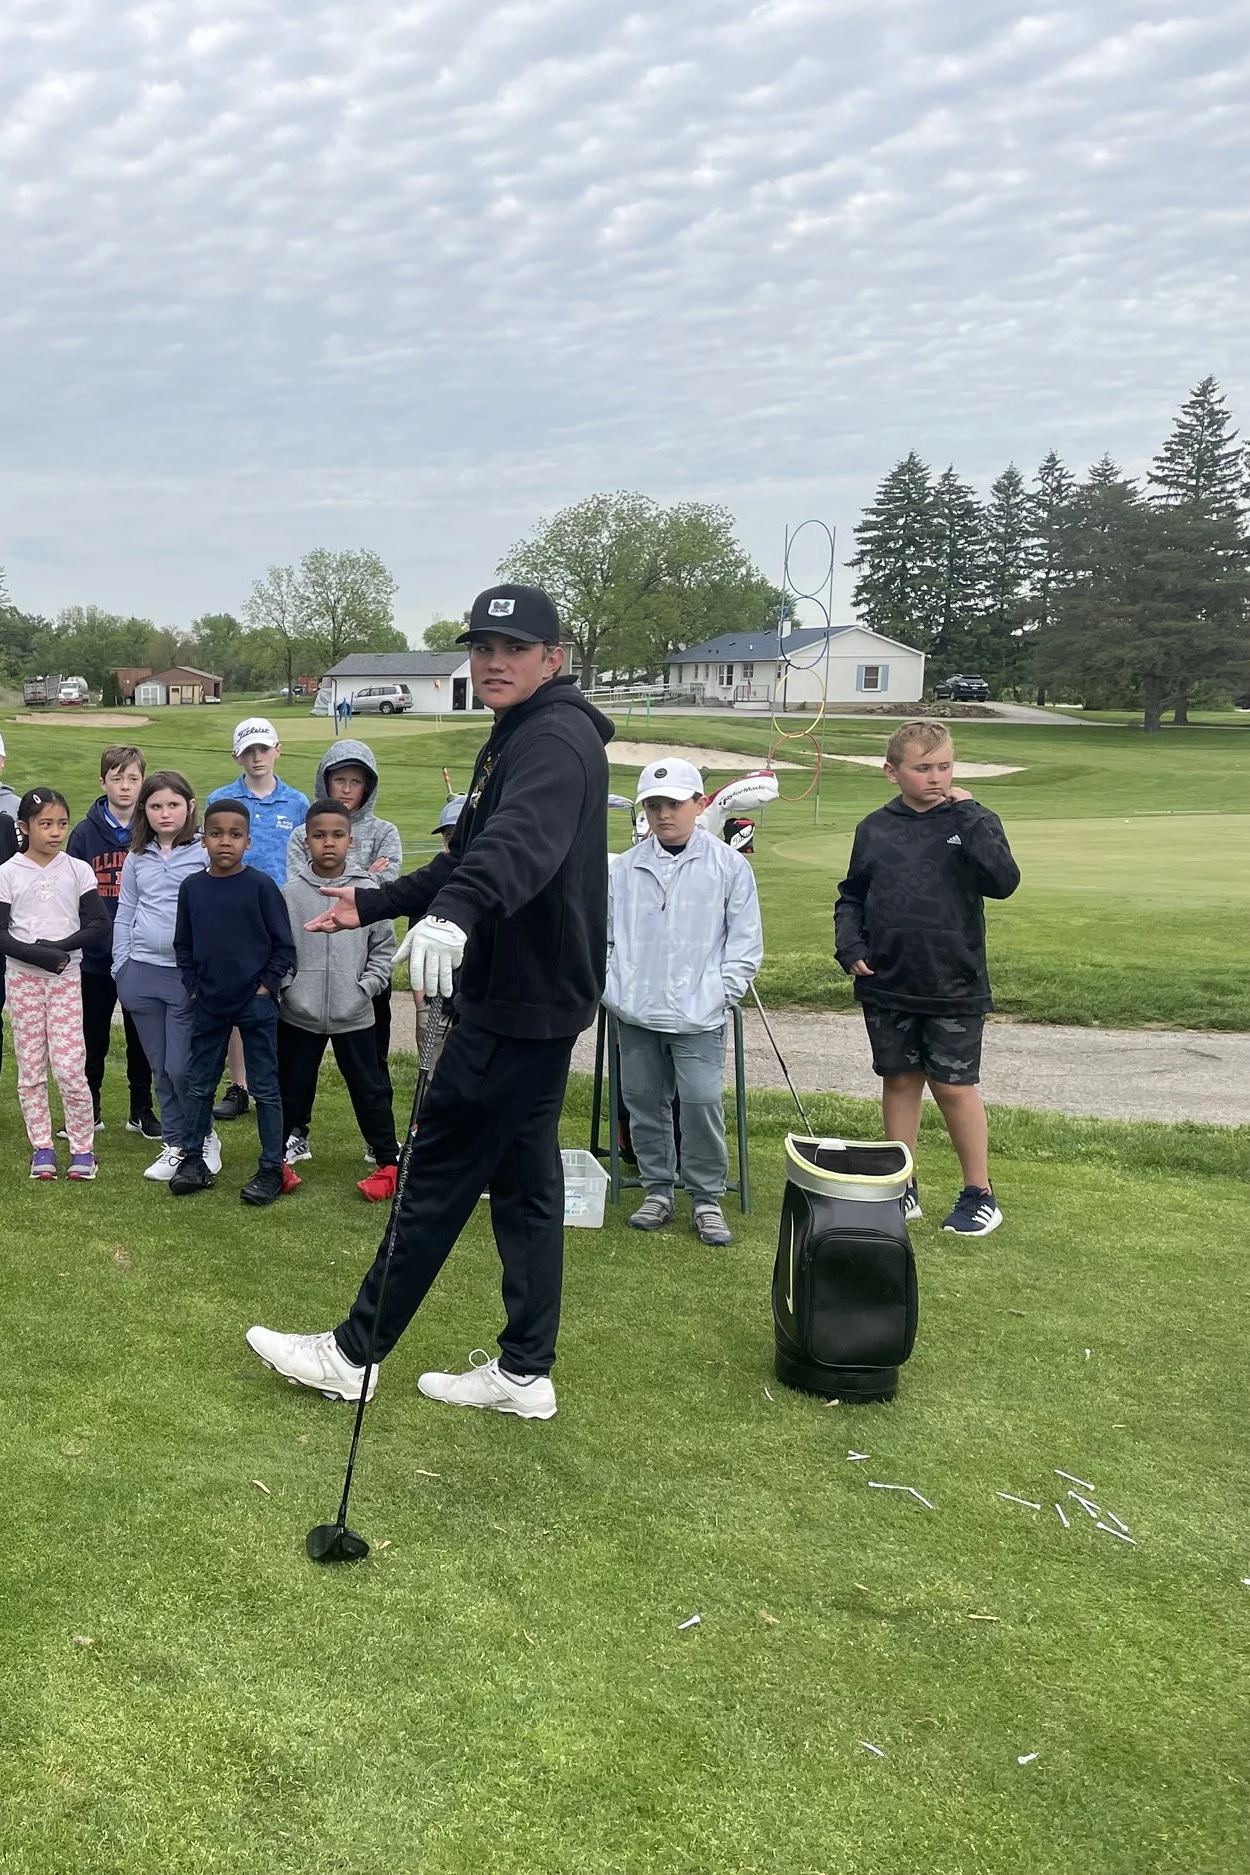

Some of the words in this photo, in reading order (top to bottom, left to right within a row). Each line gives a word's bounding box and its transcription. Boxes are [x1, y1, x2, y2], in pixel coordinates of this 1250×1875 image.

[236, 726, 270, 742] Titleist
[718, 784, 766, 806] TaylorMade
[92, 850, 128, 872] ILLIN
